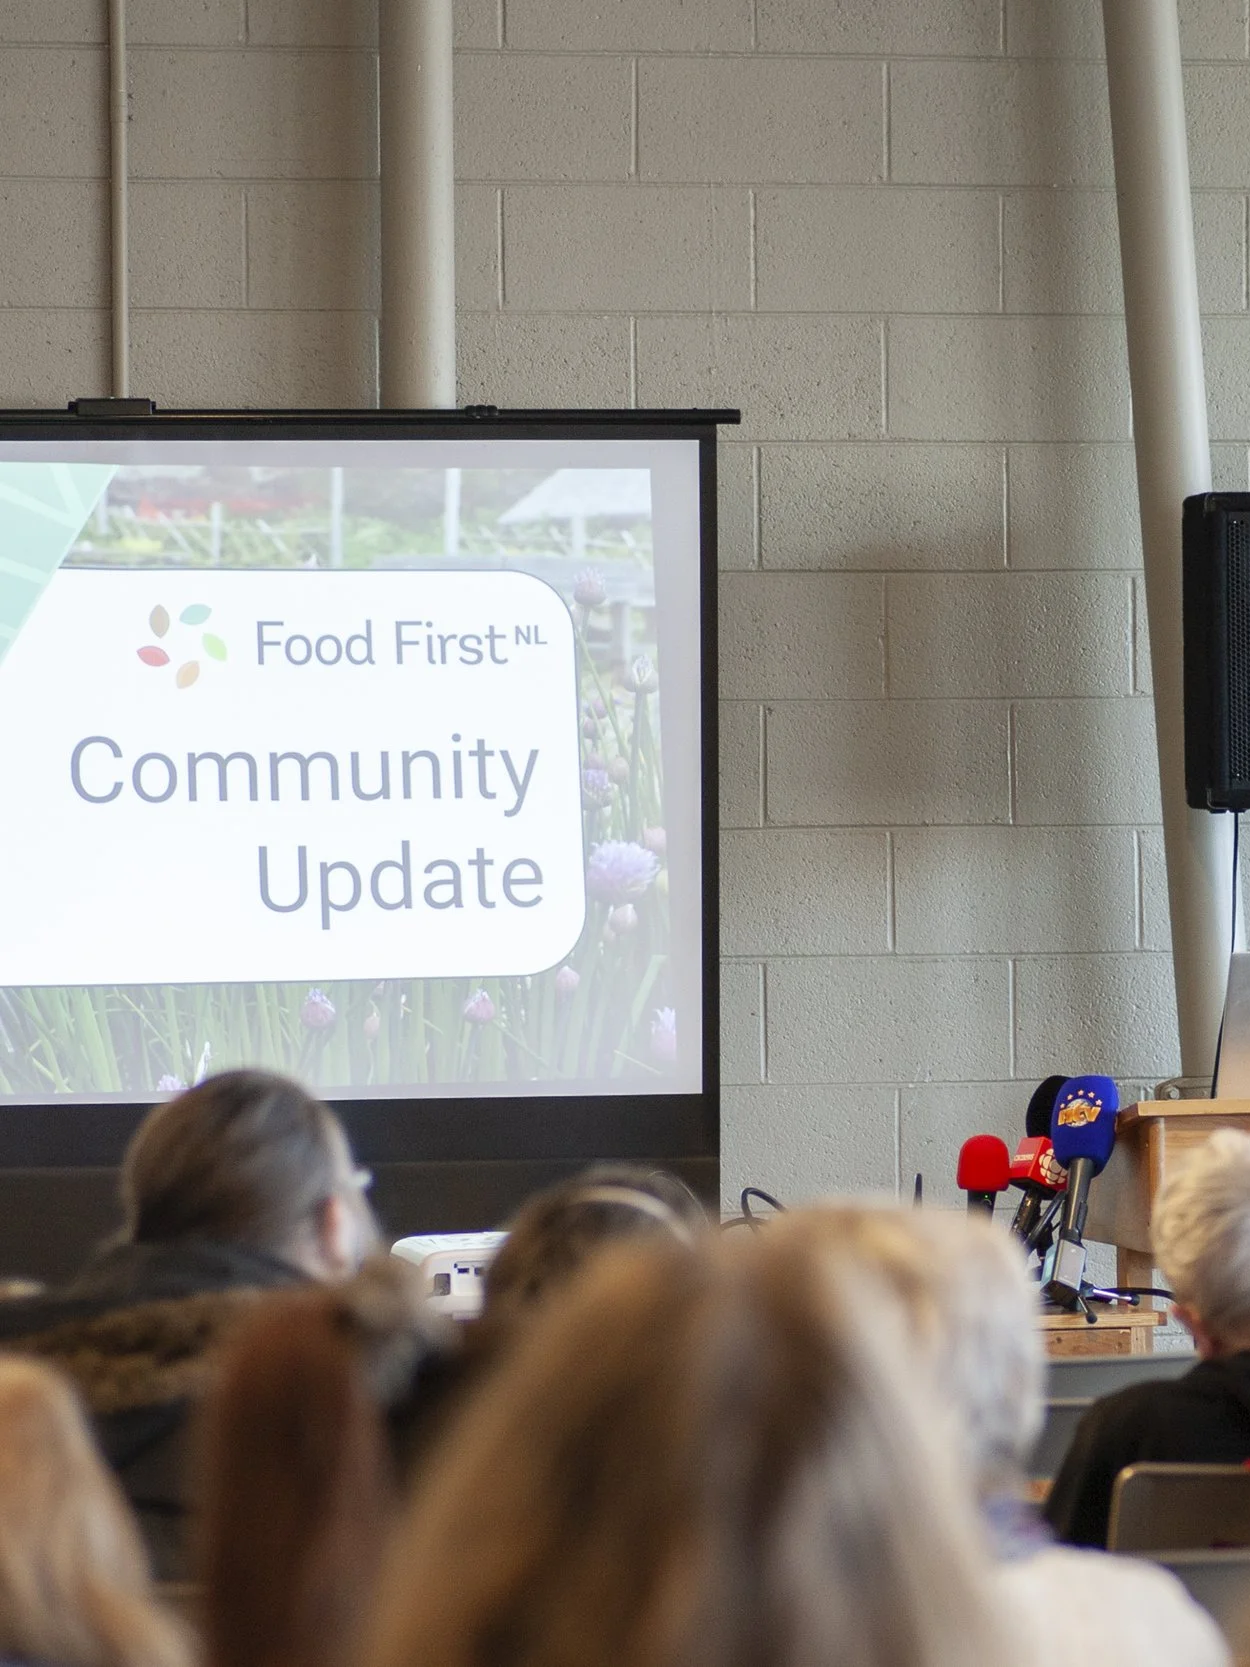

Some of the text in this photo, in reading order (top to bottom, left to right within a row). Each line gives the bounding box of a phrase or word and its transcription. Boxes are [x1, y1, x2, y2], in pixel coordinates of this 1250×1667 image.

[256, 619, 549, 666] Food First NL
[70, 733, 540, 818] Community
[258, 840, 544, 931] Update
